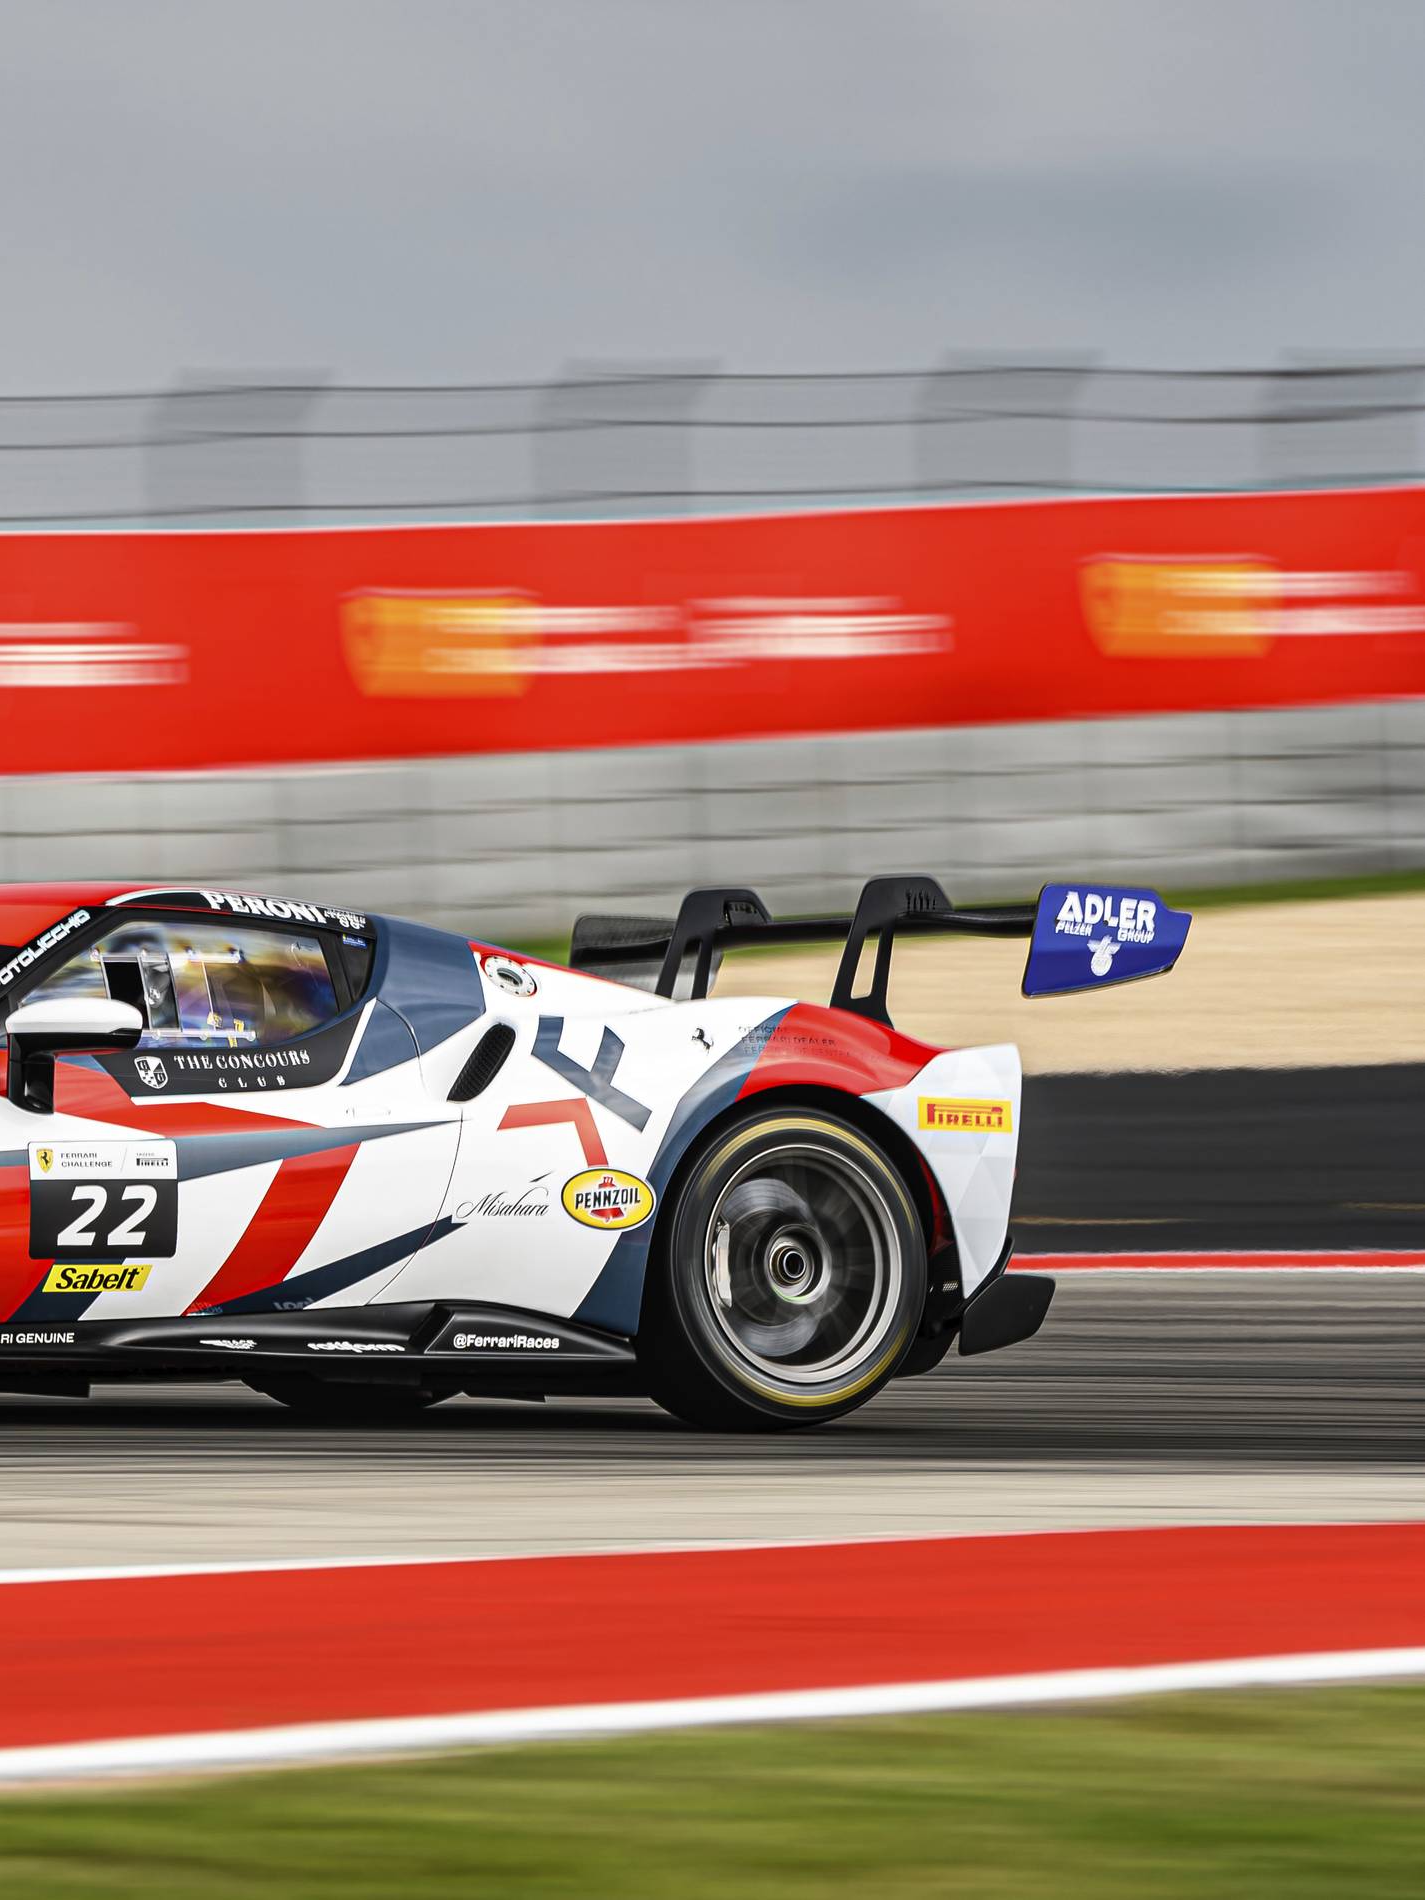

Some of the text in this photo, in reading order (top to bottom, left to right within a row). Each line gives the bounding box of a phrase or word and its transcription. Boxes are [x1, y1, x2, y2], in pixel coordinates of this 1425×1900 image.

[200, 890, 327, 924] PERONI
[1056, 891, 1157, 931] ADLER
[1055, 921, 1154, 944] PELZER GROUP
[174, 1049, 311, 1070] THE CONCOURS
[926, 1103, 1004, 1128] PIRELLI
[136, 1158, 168, 1167] PIRELLI
[455, 1186, 550, 1219] Misahara
[575, 1187, 641, 1210] PENNZOIL
[57, 1184, 158, 1247] 22
[55, 1266, 142, 1292] Sabelt
[15, 1332, 75, 1344] GENUINE
[453, 1332, 561, 1351] @FerrariRaces
